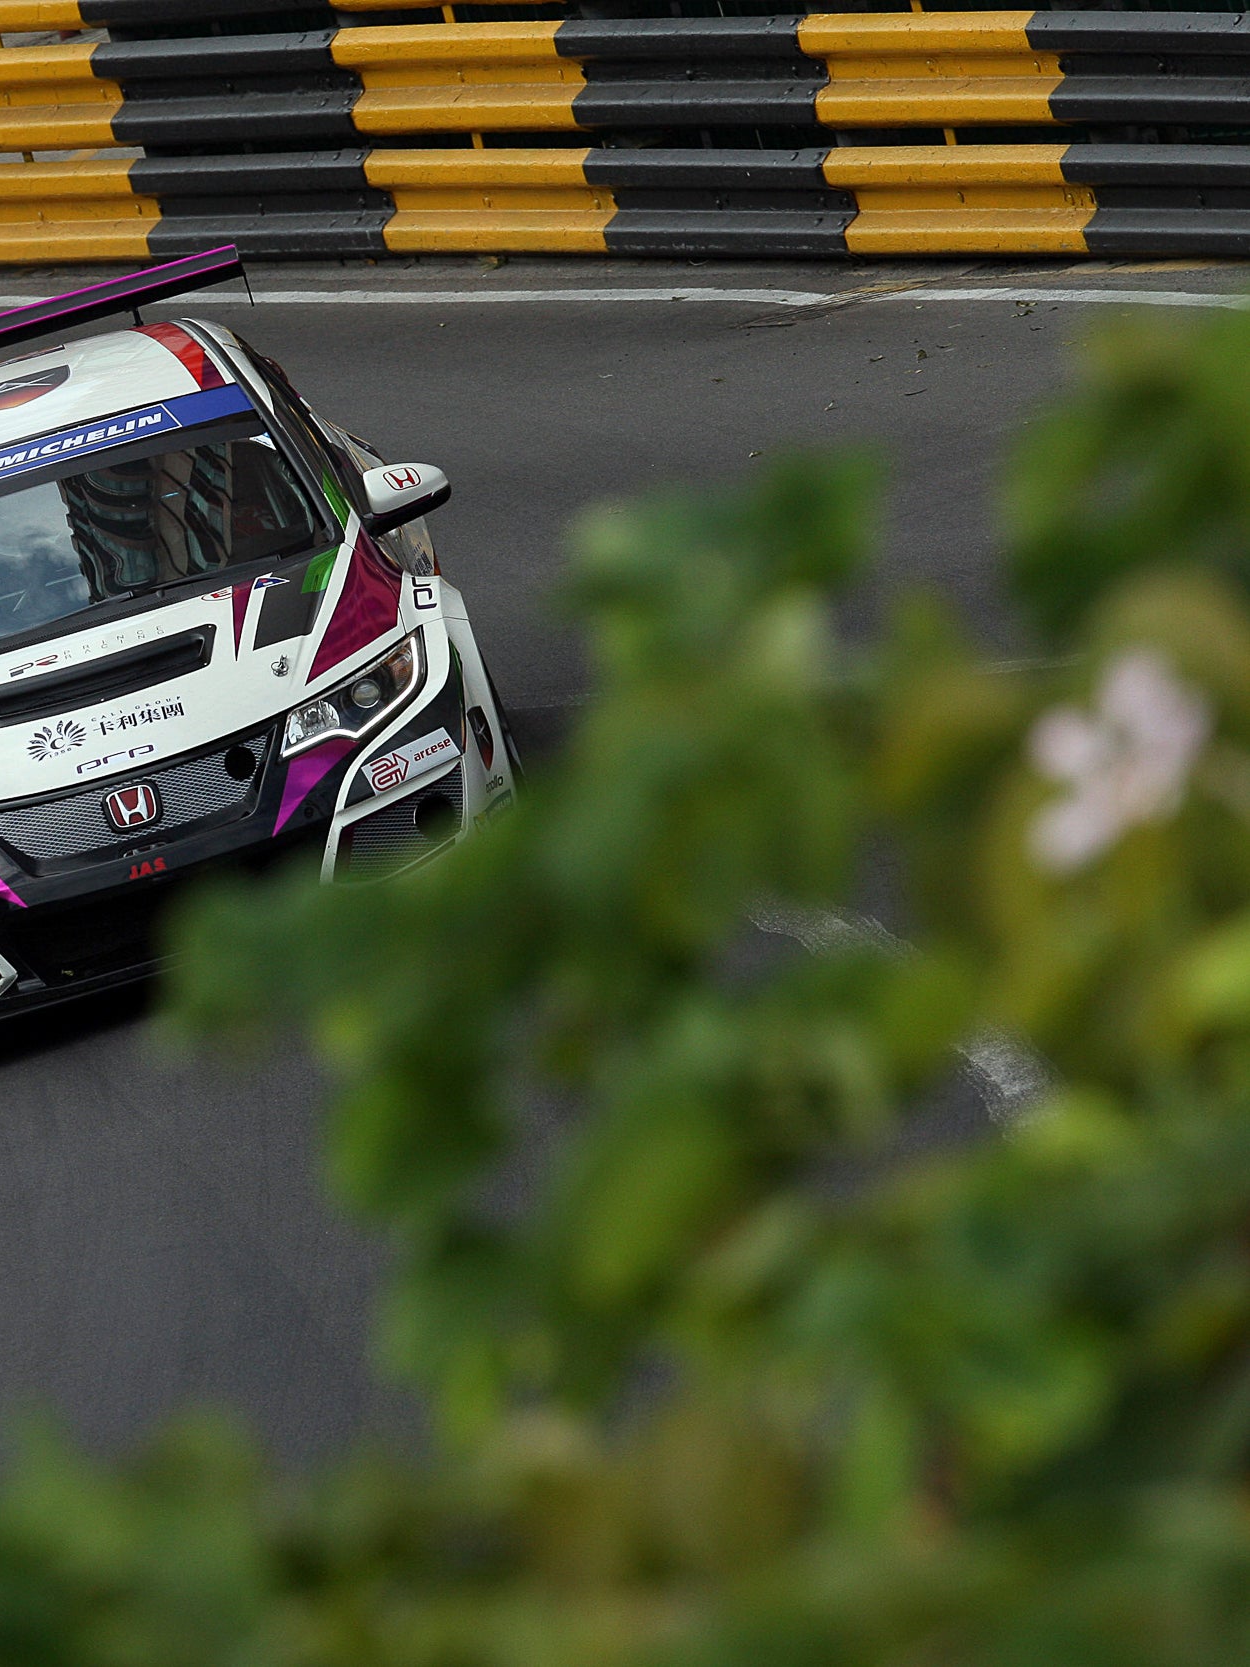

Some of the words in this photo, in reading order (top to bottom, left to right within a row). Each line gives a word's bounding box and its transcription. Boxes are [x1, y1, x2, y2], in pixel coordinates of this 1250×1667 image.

[91, 710, 124, 722] CALI
[134, 696, 181, 710] GROUP
[93, 702, 185, 736] 卡利集團
[413, 737, 451, 762] arcese
[129, 857, 167, 879] JAS
